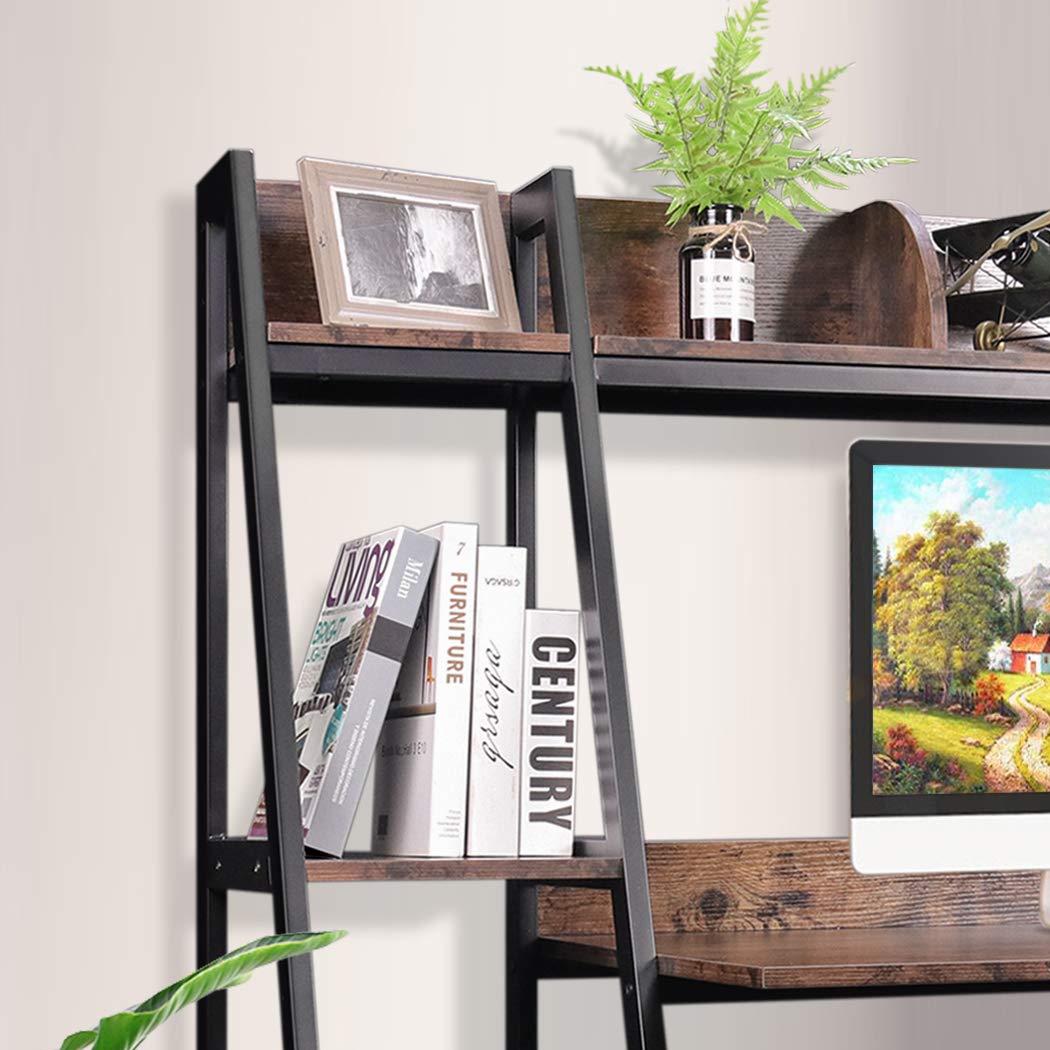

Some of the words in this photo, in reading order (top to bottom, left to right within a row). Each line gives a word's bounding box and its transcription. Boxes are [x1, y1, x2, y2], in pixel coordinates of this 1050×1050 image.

[397, 557, 424, 599] Milan
[456, 541, 466, 556] 7
[446, 572, 468, 684] FURNITURE
[529, 636, 577, 830] CENTURY
